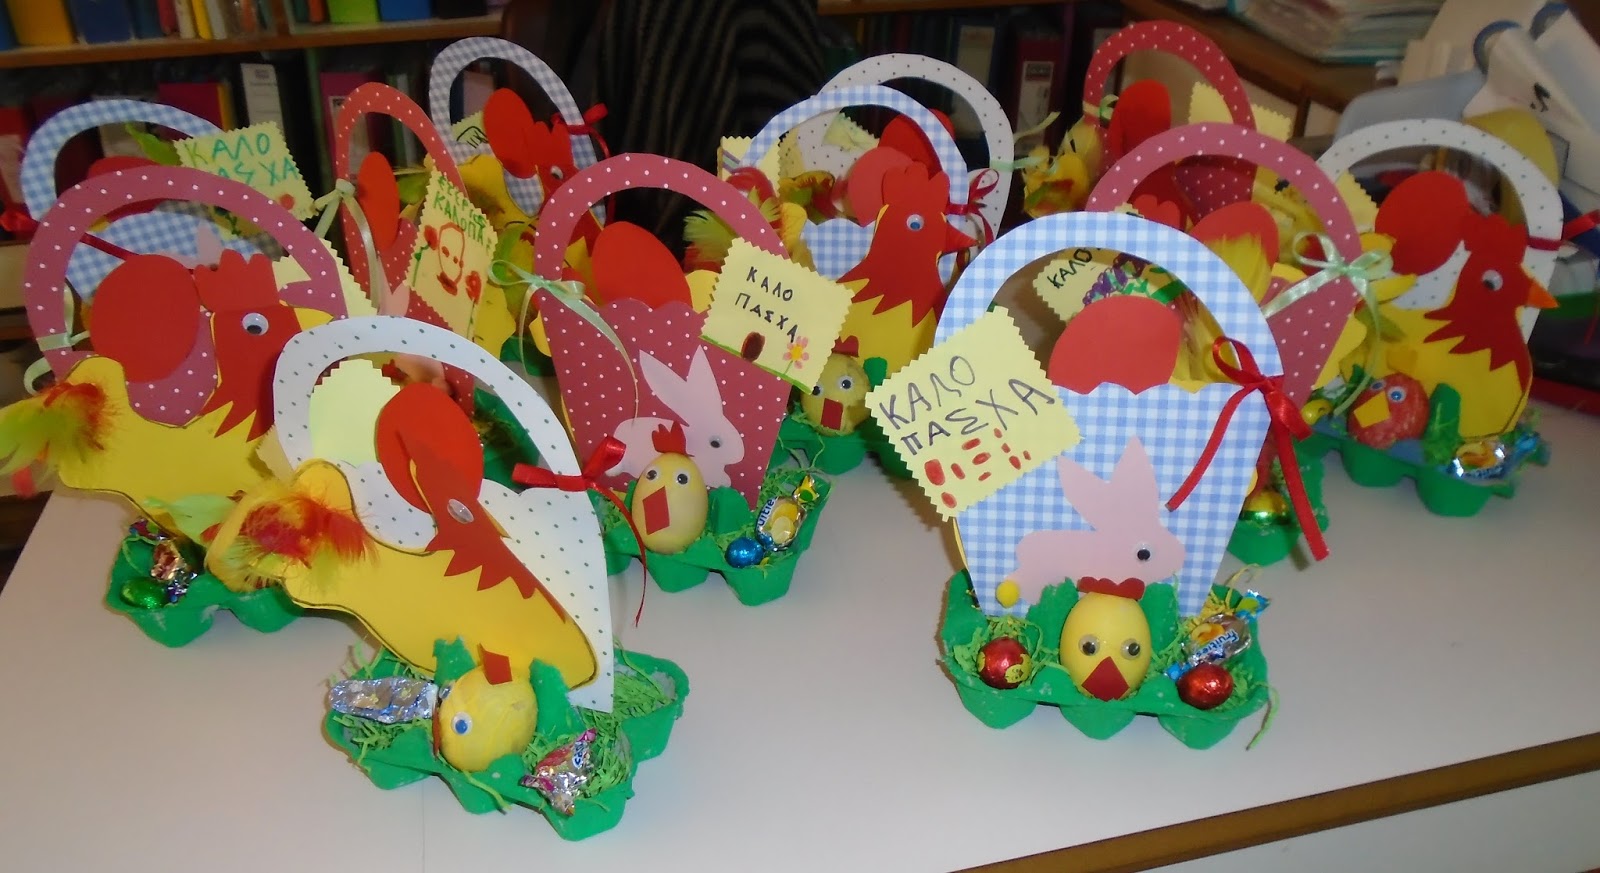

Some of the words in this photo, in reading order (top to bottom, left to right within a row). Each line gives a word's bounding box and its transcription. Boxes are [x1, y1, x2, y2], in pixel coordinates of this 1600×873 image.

[183, 132, 271, 166] ΚΑΛΟ
[217, 156, 299, 187] ΑΣΧΑ
[746, 266, 793, 302] ΚΑΛΟ
[1047, 248, 1093, 289] ΚΑΛΟ
[734, 292, 798, 343] ΠΑΣΧΑ
[879, 355, 976, 430] ΚΑΛΟ
[901, 378, 1056, 456] ΠΑΣΧΑ
